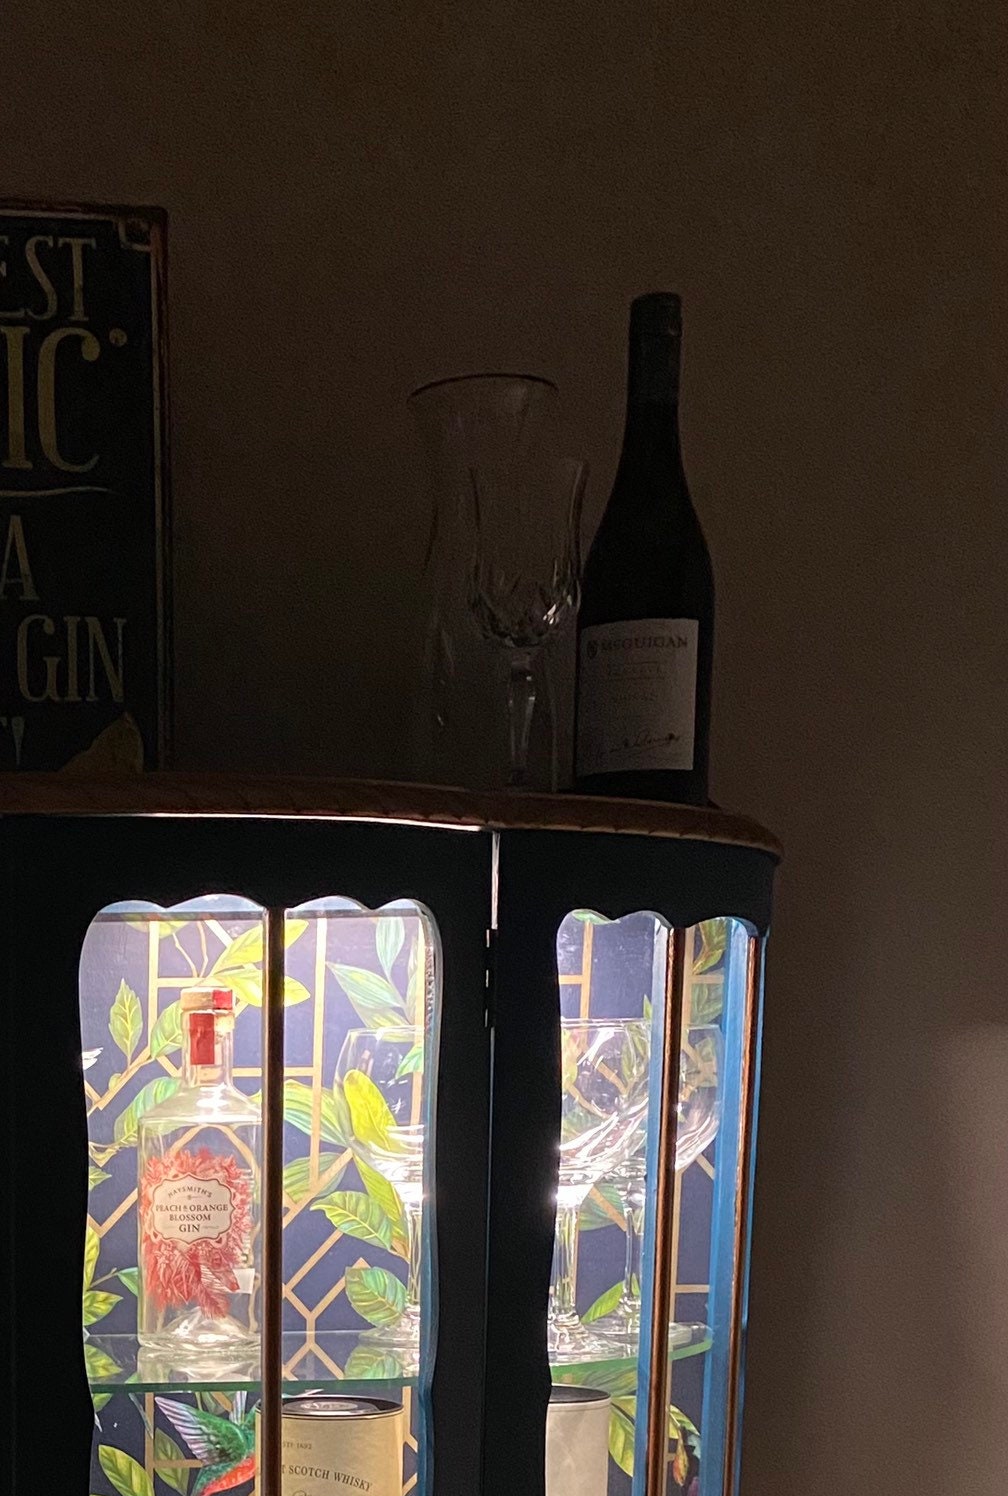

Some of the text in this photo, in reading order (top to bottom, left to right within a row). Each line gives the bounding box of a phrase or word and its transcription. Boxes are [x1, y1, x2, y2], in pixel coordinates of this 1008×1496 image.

[16, 614, 127, 704] GIN
[167, 1186, 213, 1199] HAYSMITH'S
[155, 1204, 182, 1212] PEACH
[189, 1204, 229, 1212] ORANGE
[169, 1213, 211, 1222] BLOSSOM
[179, 1224, 200, 1233] GIN
[289, 1465, 330, 1480] SCOTCH
[333, 1472, 371, 1492] WHISKY
